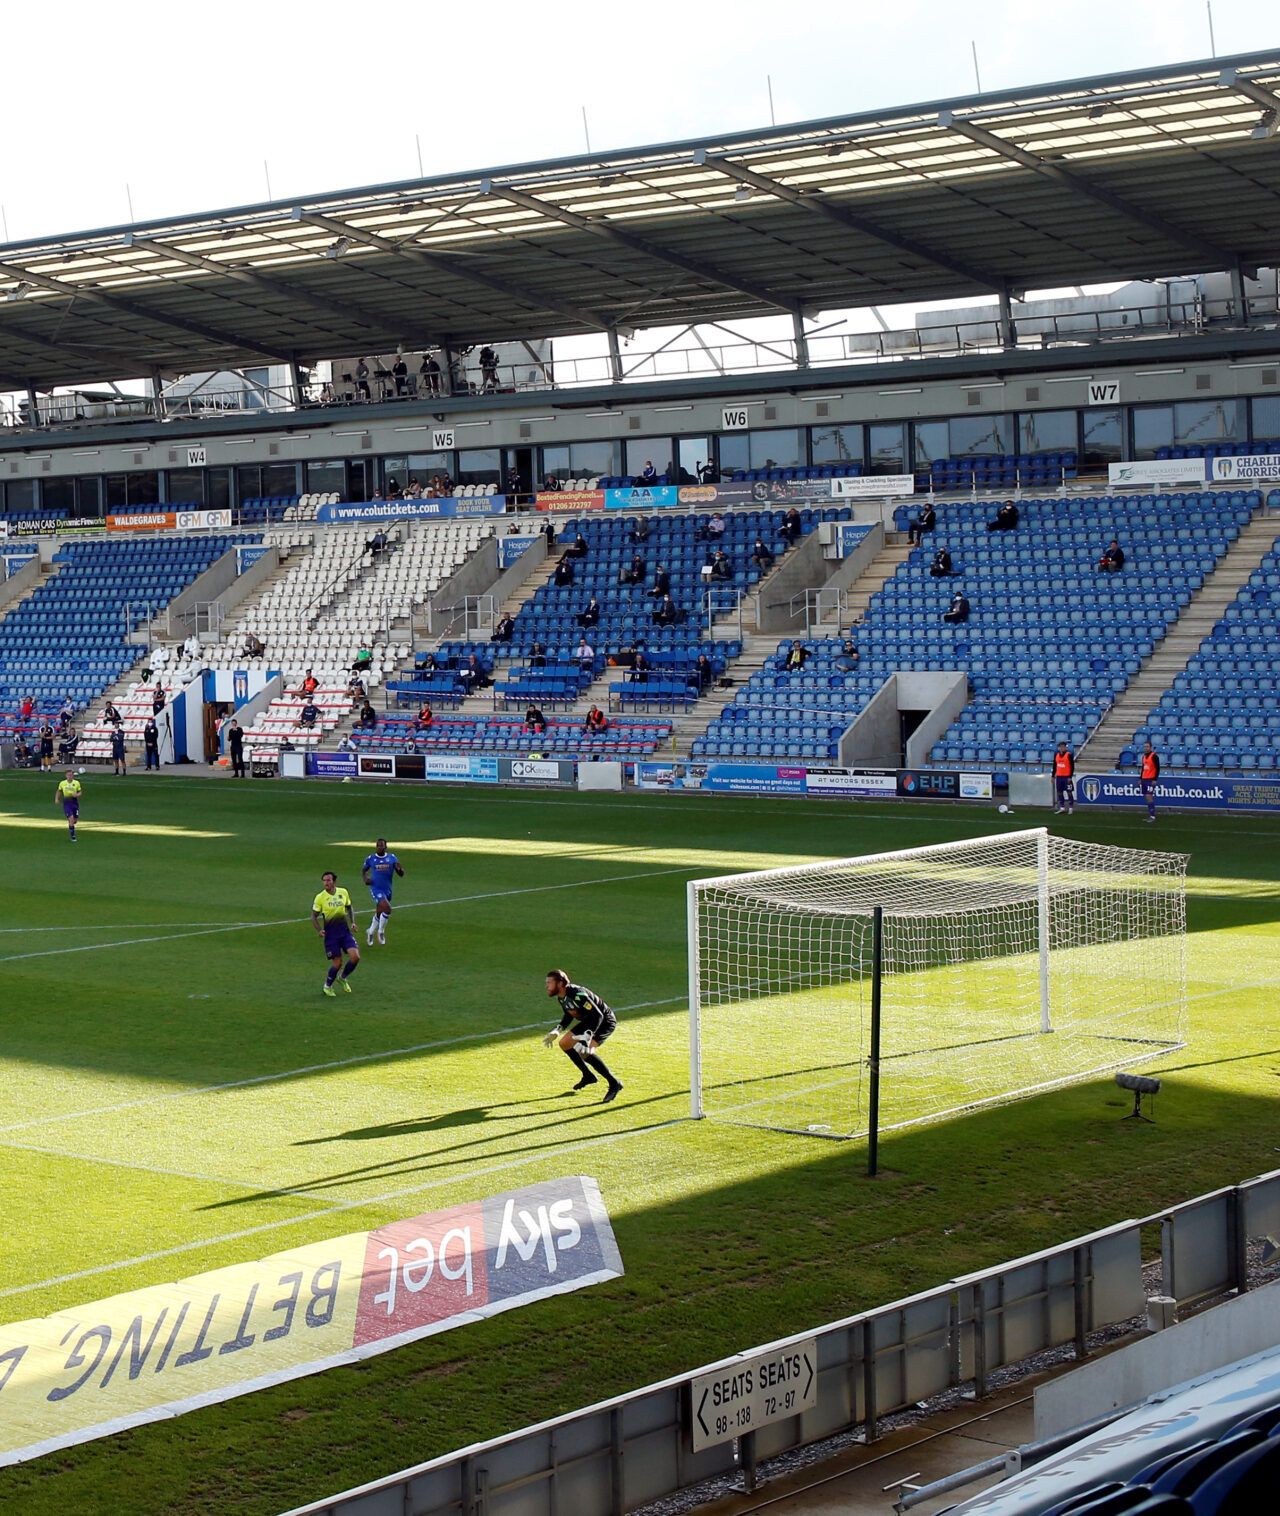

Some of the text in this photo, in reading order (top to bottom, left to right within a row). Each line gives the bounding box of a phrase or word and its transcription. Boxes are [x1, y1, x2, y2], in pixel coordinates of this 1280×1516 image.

[1091, 385, 1117, 401] W7
[725, 412, 746, 426] W6
[435, 434, 453, 446] W5
[189, 451, 205, 464] W4
[1237, 467, 1280, 477] MORRIS
[338, 503, 440, 518] www.colutickets.com
[548, 502, 568, 510] 01206
[17, 519, 56, 530] ROMAN CARS
[114, 515, 166, 526] WALDEGRAVES
[179, 510, 230, 527] GFM GFM
[920, 776, 955, 789] EHP
[1103, 784, 1223, 799] theticthub.co.uk
[495, 1198, 582, 1273] sky
[374, 1226, 473, 1315] bet
[46, 1259, 343, 1402] BETTING,
[713, 1354, 800, 1406] SEATS SEATS
[716, 1415, 727, 1435] 98
[736, 1405, 751, 1427] 138
[765, 1397, 777, 1416] 72
[785, 1389, 796, 1409] 97
